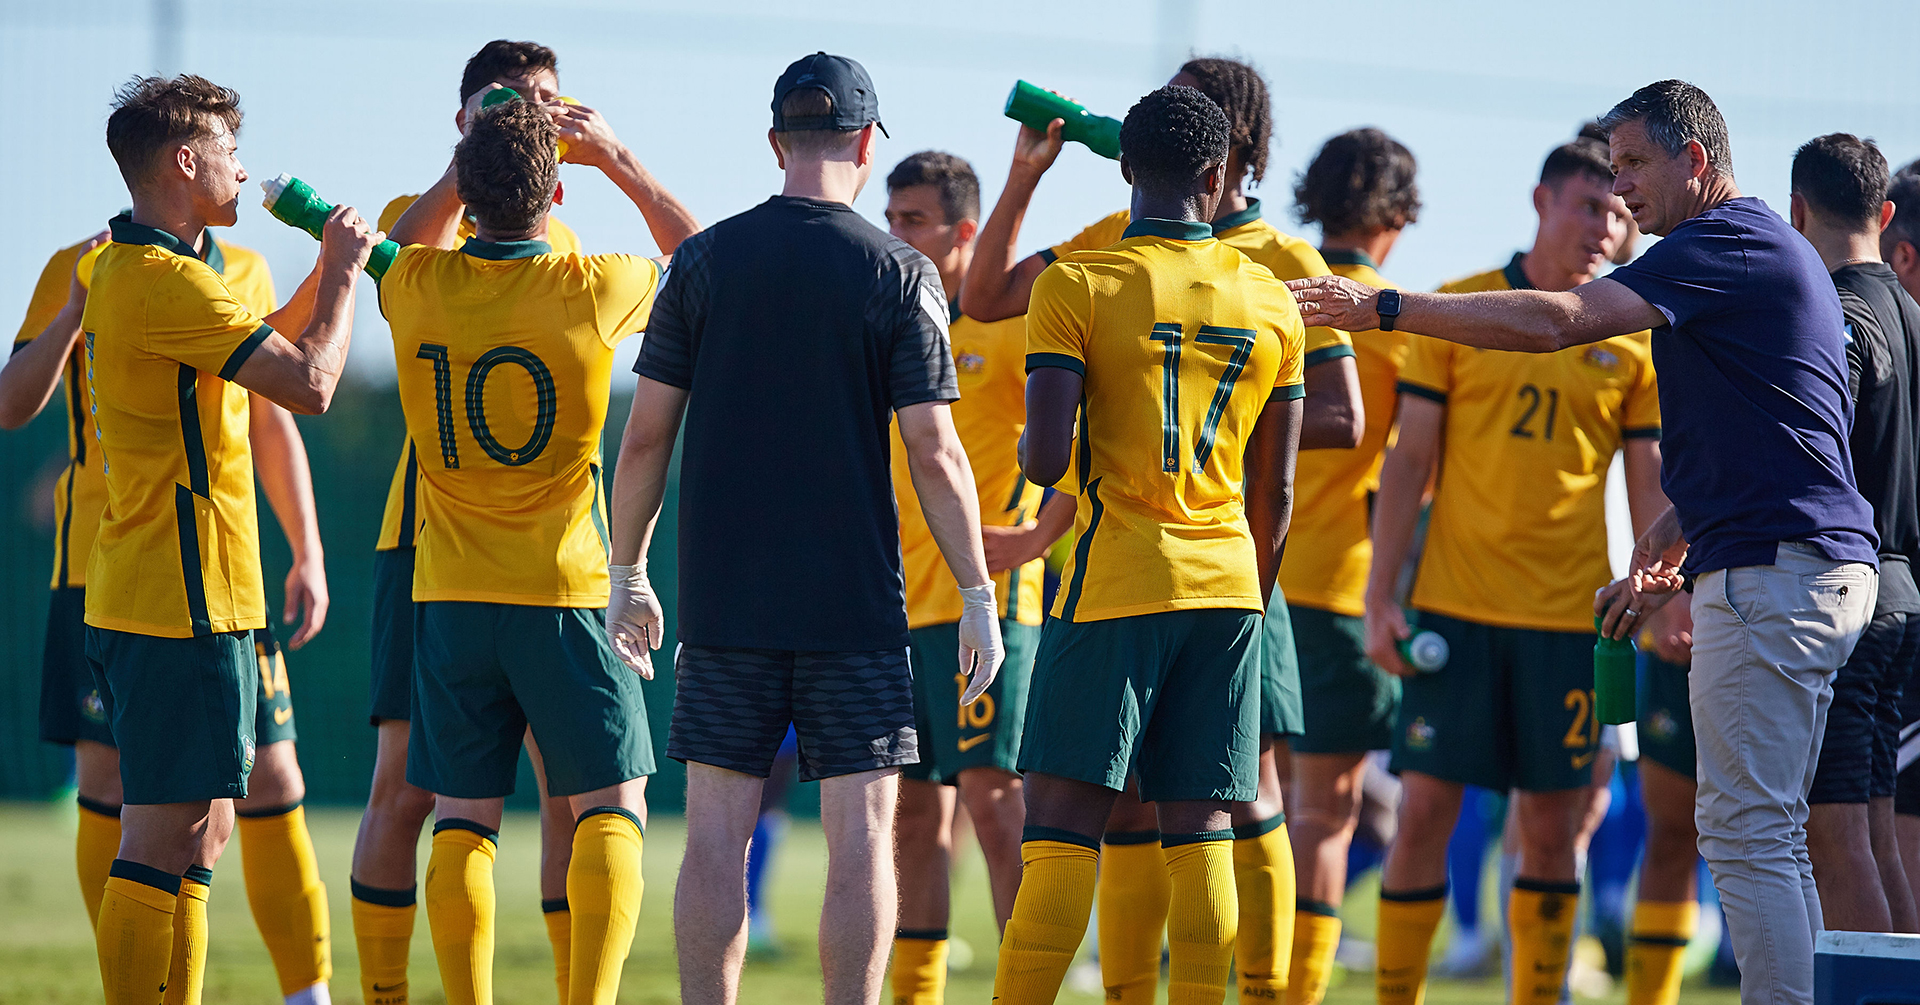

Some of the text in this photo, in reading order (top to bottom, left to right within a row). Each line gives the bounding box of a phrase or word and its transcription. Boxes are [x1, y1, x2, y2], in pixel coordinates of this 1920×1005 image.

[416, 343, 557, 469] 10
[1149, 322, 1257, 475] 17
[1511, 383, 1558, 441] 21
[1243, 986, 1276, 999] AUS
